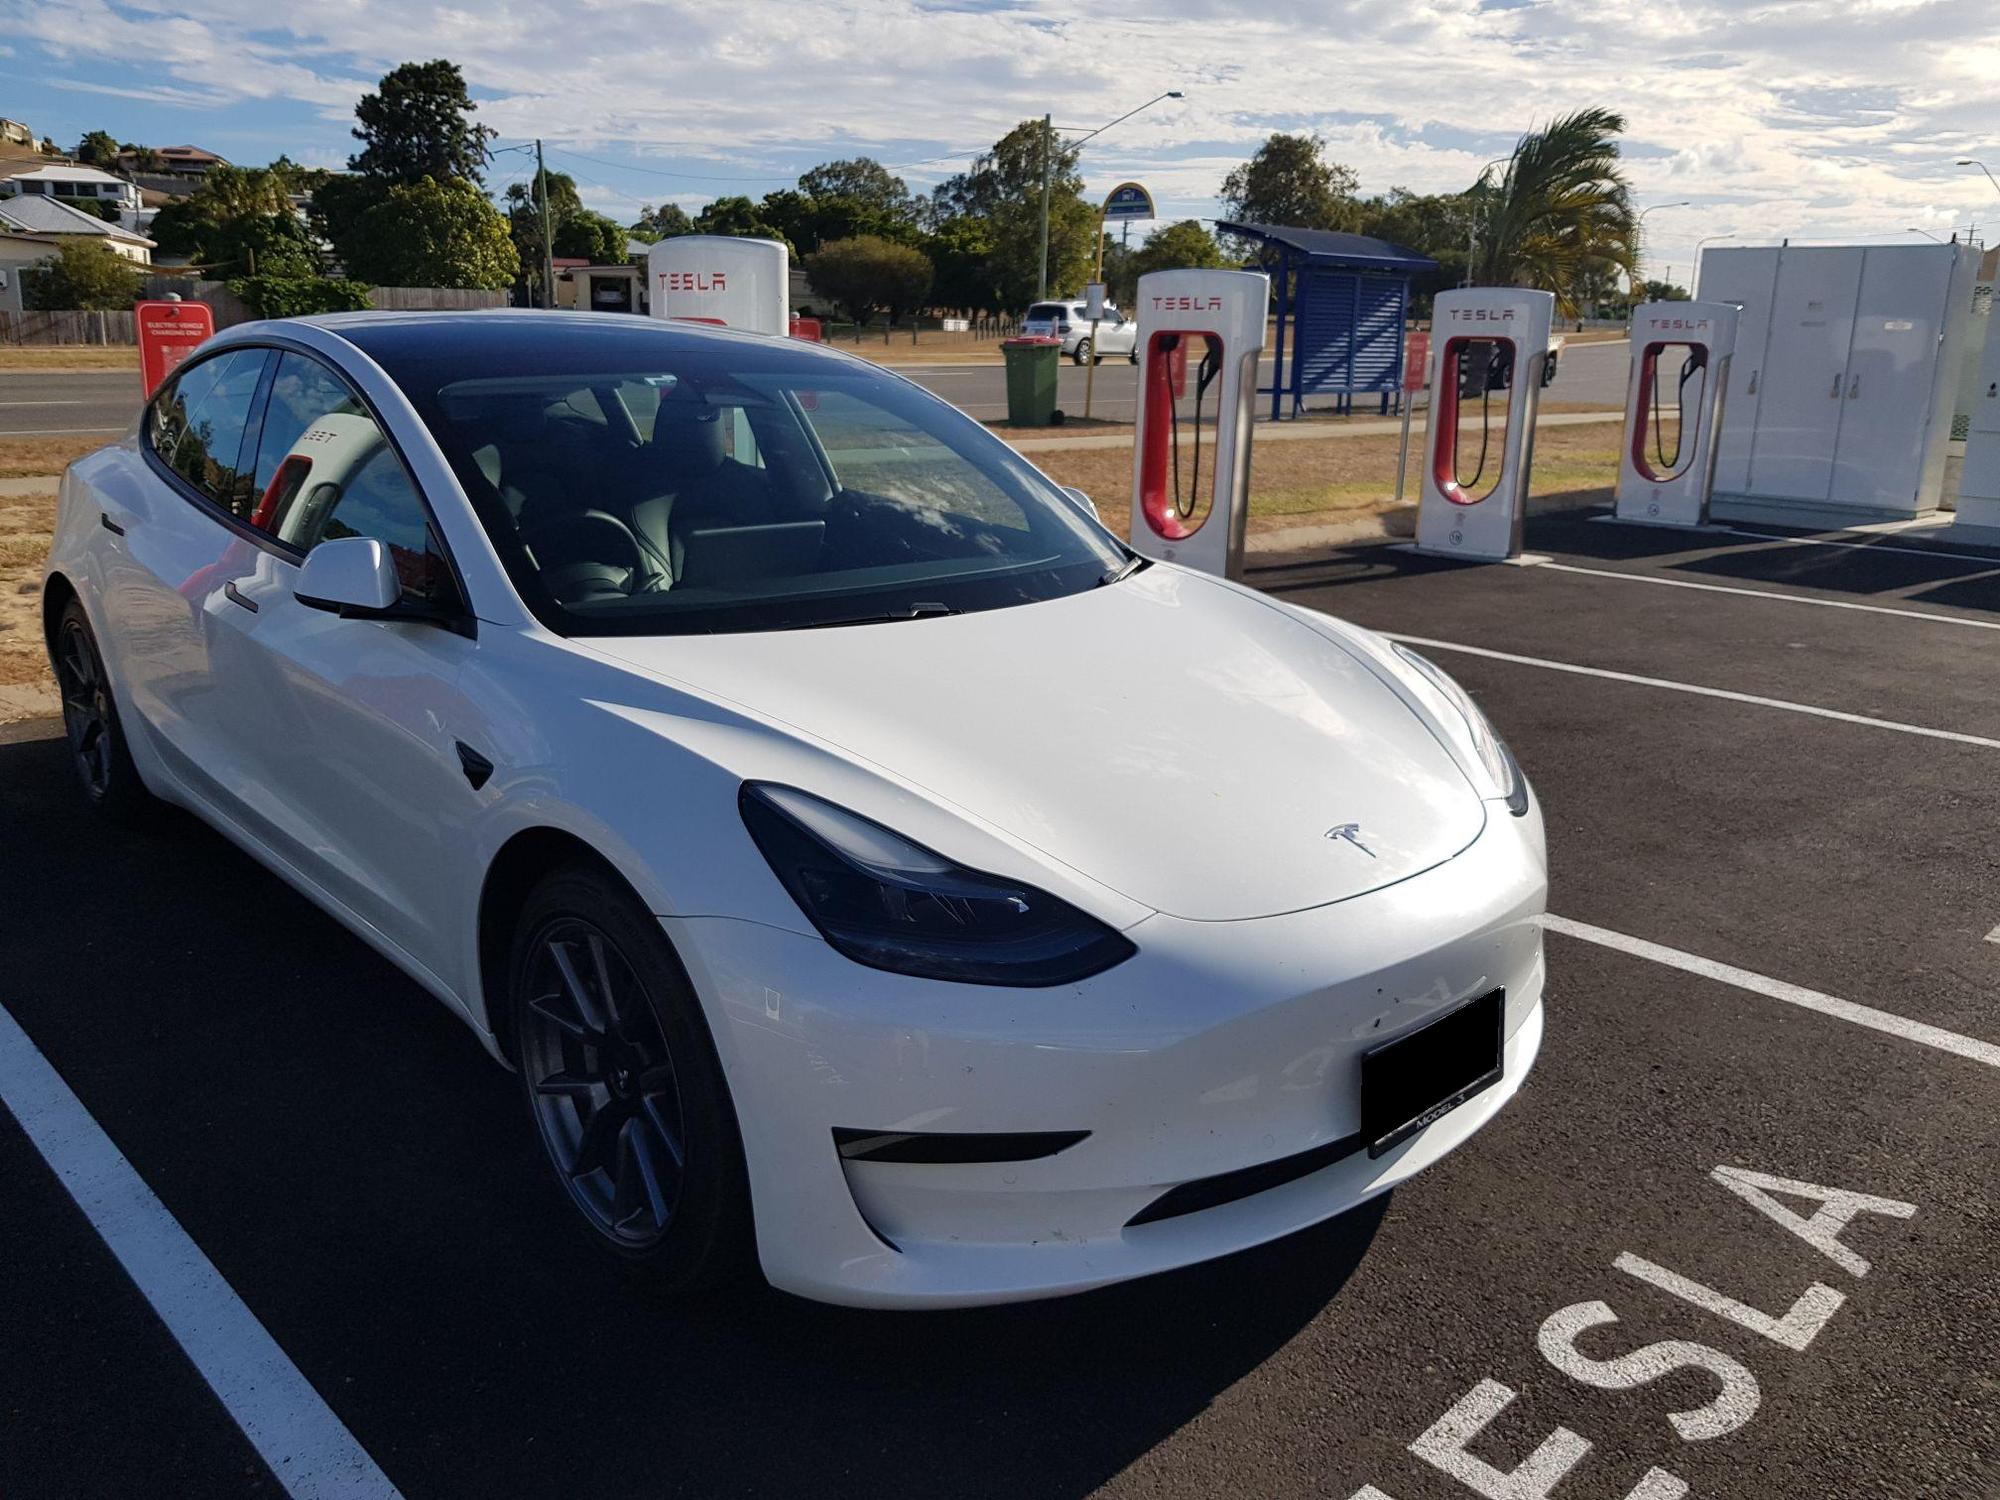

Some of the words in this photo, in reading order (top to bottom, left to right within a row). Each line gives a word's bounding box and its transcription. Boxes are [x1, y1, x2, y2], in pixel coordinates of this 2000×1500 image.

[658, 273, 726, 291] TESLA
[1152, 297, 1222, 311] TESLA
[1450, 308, 1515, 321] TESLA
[1649, 319, 1708, 329] TESLA
[1416, 1103, 1453, 1129] MODEL
[1347, 1164, 1918, 1500] ESLA
